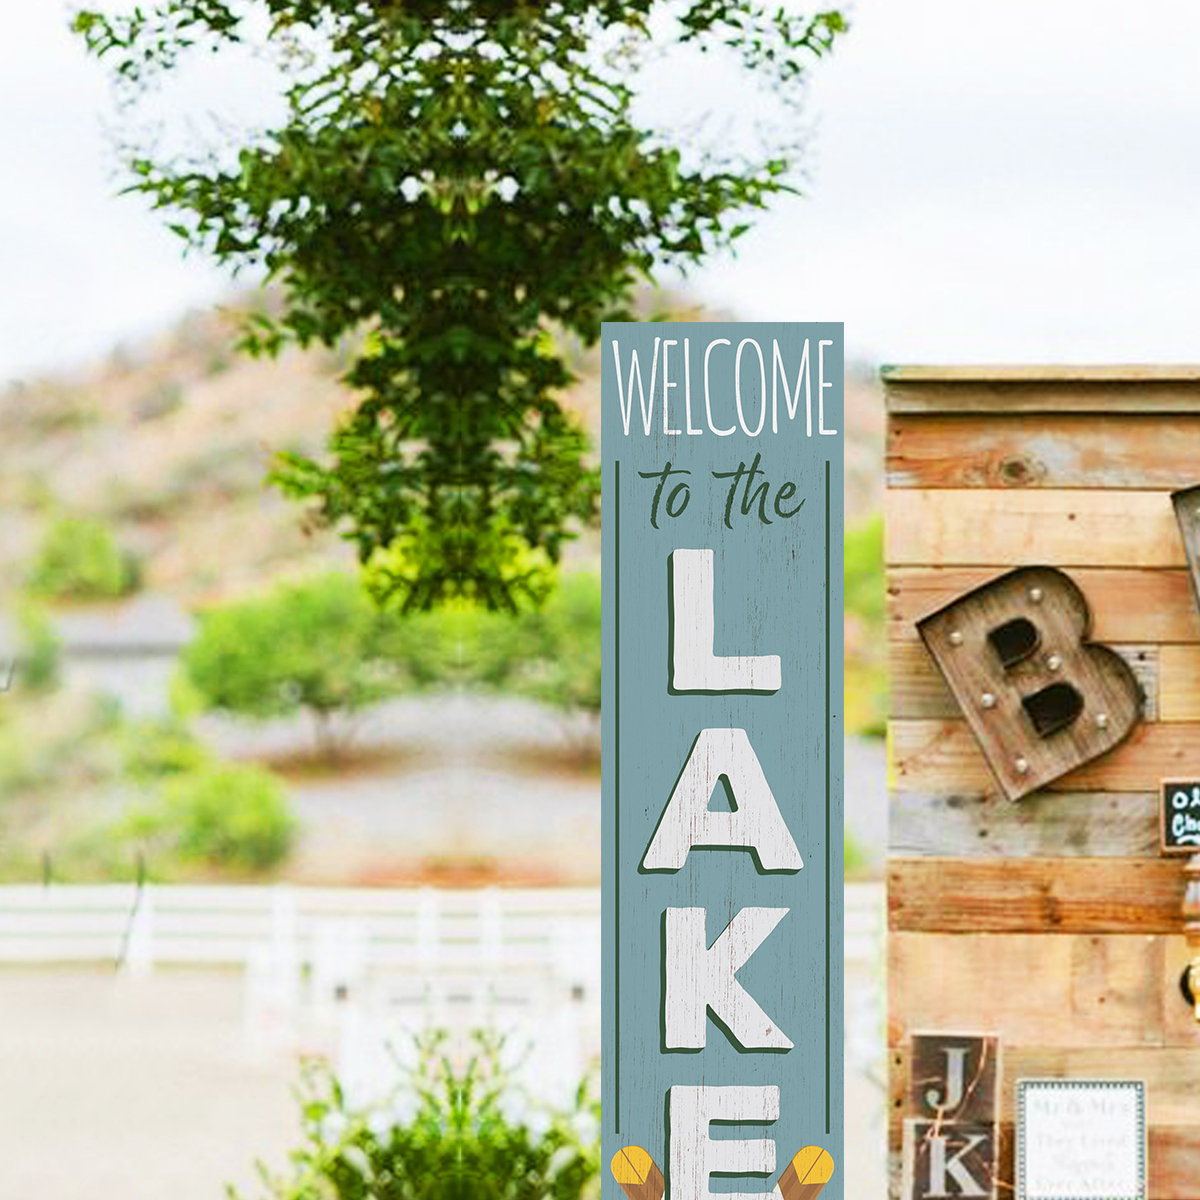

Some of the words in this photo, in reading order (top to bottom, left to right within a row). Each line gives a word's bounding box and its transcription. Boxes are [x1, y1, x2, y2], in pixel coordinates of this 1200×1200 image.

[612, 336, 838, 437] WELCOME
[638, 461, 692, 530] to
[712, 452, 806, 530] the
[925, 1047, 971, 1112] J
[921, 1133, 992, 1199] K
